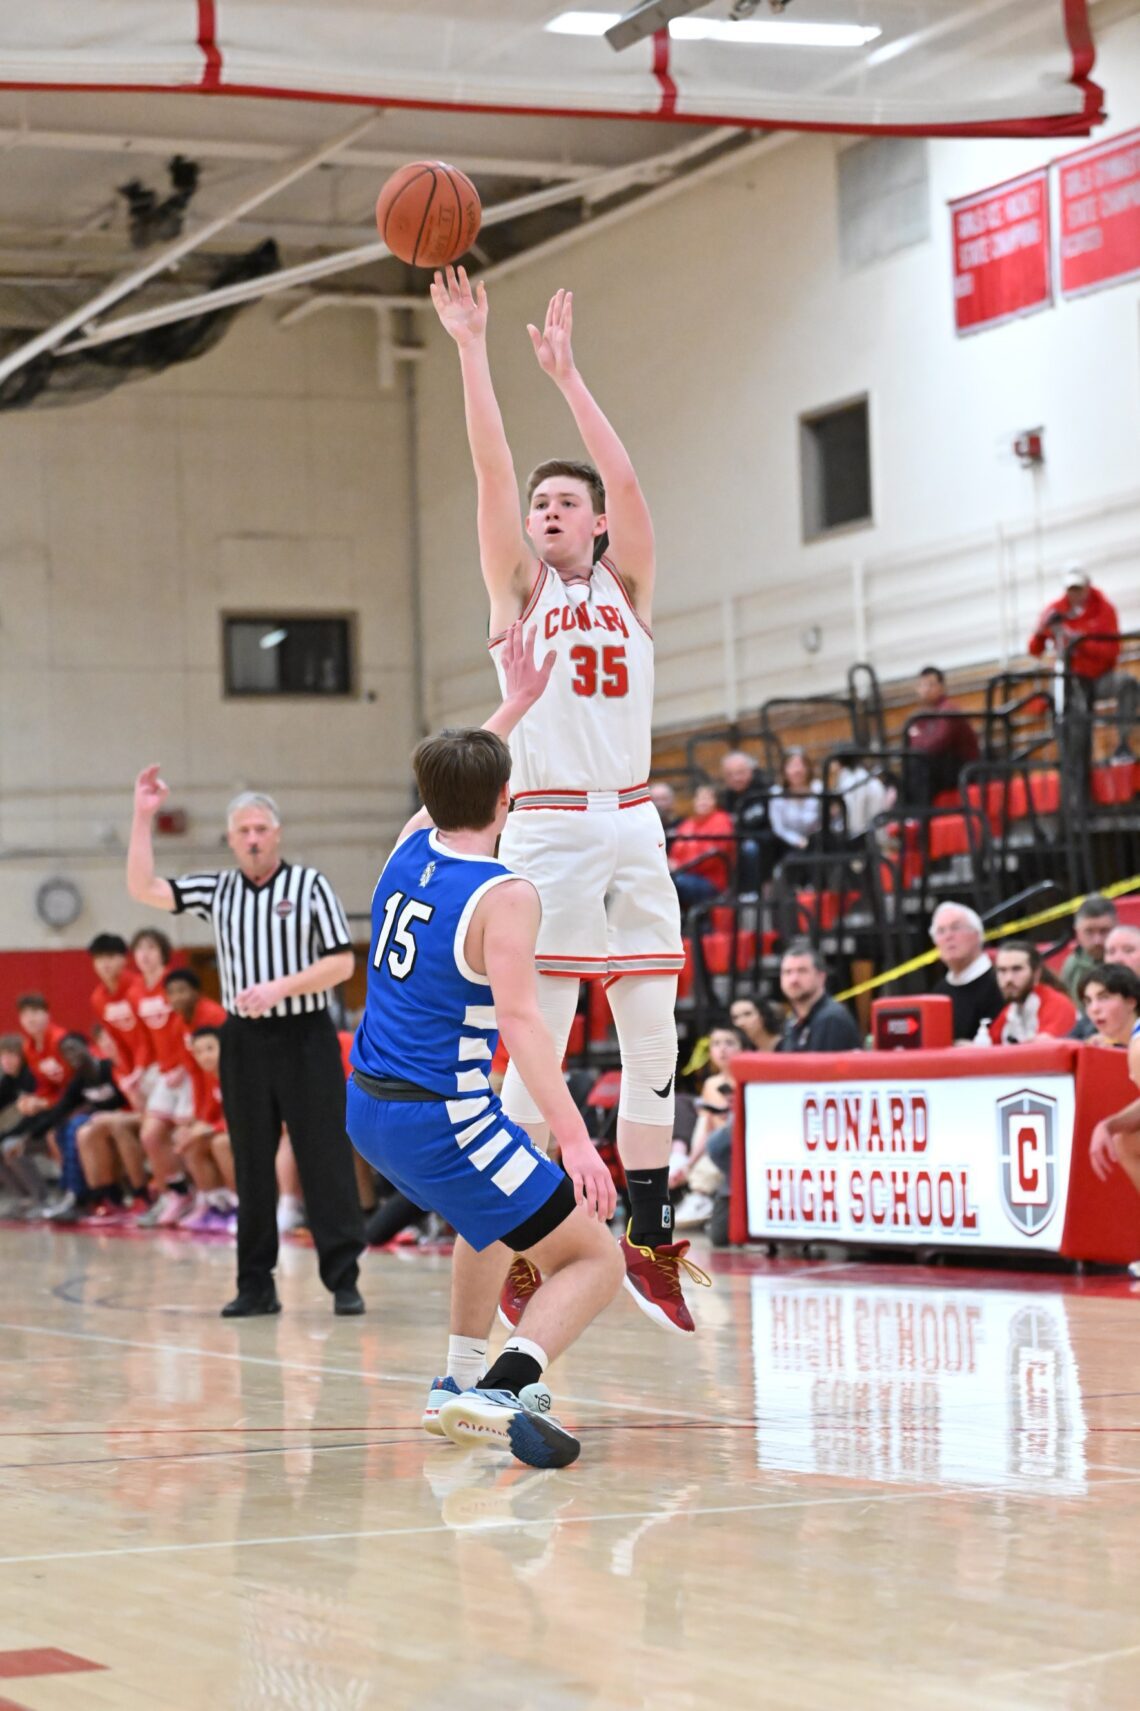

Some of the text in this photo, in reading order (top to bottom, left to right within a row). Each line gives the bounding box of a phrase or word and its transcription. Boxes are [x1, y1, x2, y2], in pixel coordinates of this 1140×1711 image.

[544, 600, 630, 641] CONR
[569, 643, 629, 699] 35
[372, 889, 436, 984] 15
[803, 1093, 930, 1154] CONARD
[765, 1167, 979, 1231] HIGH SCHOOL
